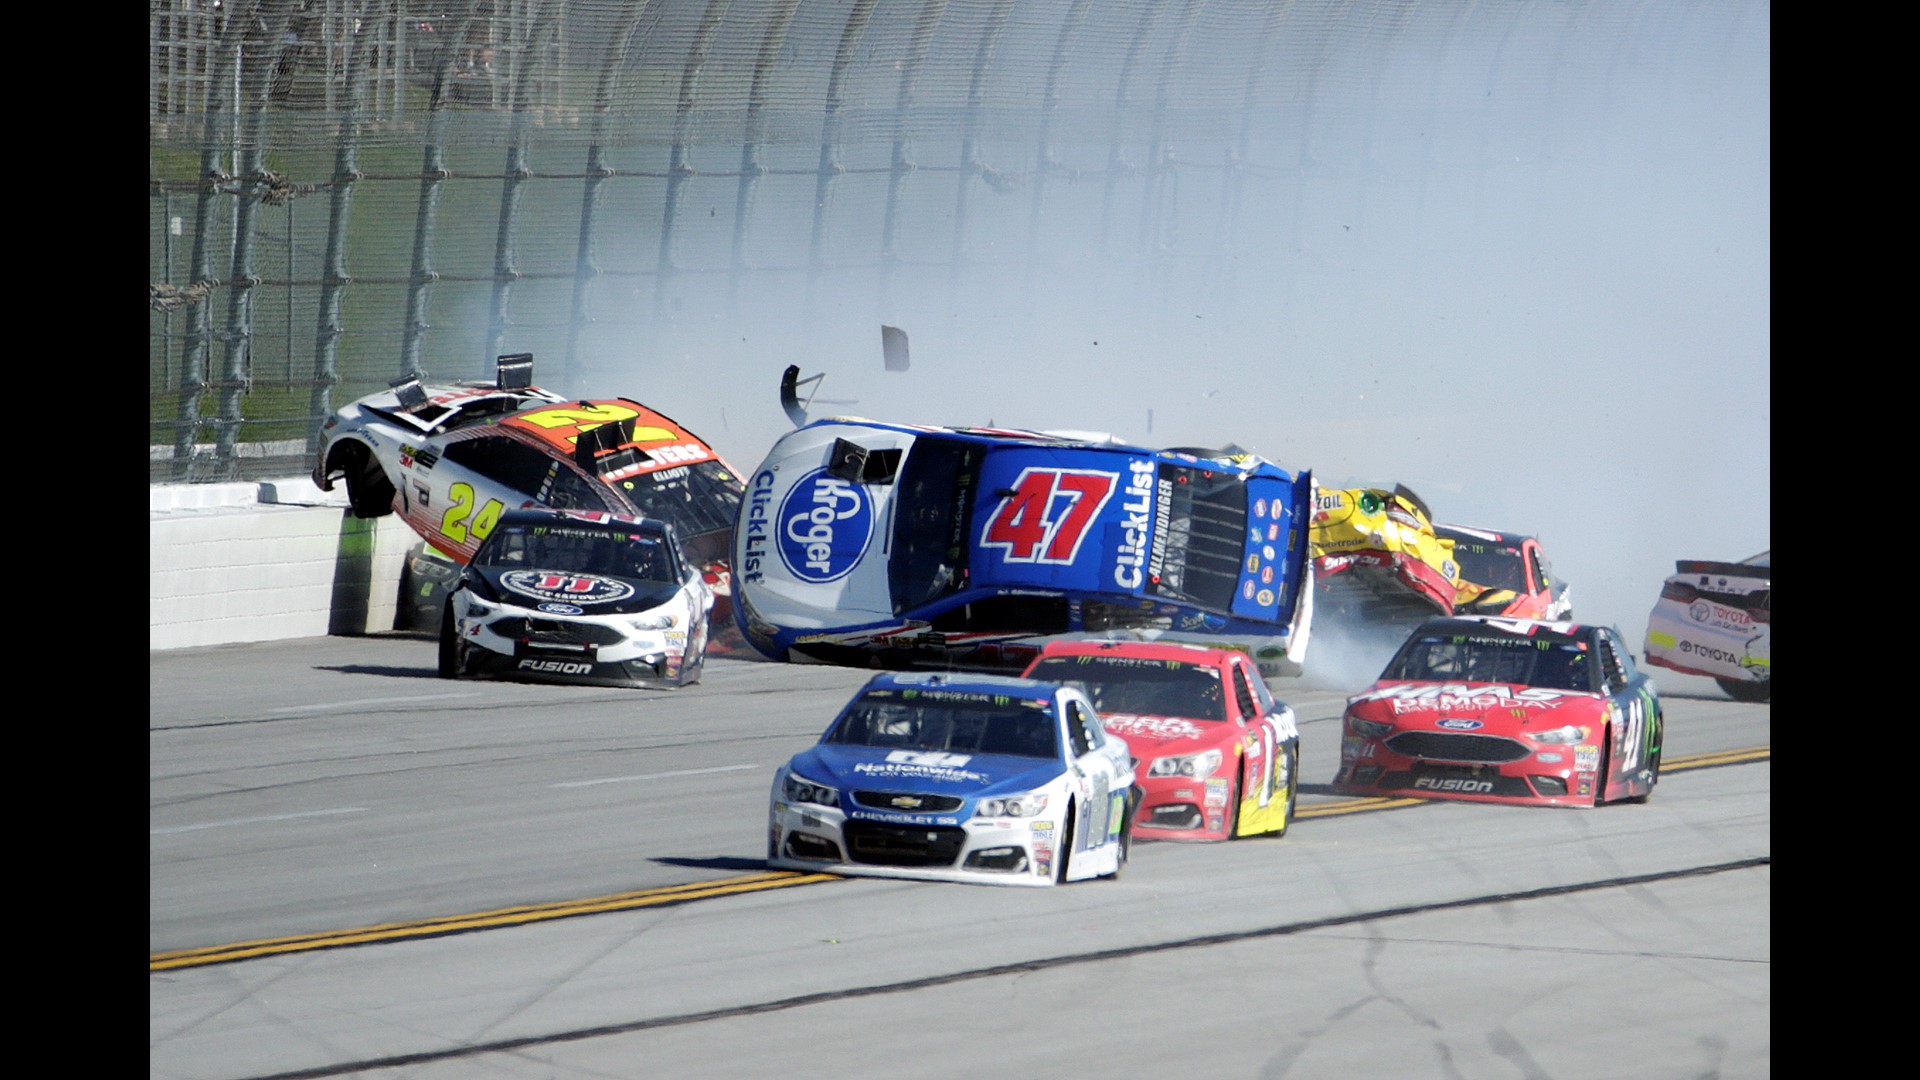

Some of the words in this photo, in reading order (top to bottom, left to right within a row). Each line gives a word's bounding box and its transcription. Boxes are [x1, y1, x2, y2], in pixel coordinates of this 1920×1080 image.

[652, 466, 692, 482] ELLIOTT
[439, 482, 505, 546] 24
[980, 466, 1121, 566] 47
[1113, 458, 1155, 589] ClickList
[744, 469, 775, 585] ClickList
[787, 477, 862, 574] Kroger
[1147, 477, 1174, 578] ALLMENDINGER
[1713, 606, 1750, 625] TOYOTA
[470, 625, 481, 636] 4
[1694, 643, 1737, 664] TOYOTA
[518, 659, 593, 675] FUSION
[1499, 697, 1563, 710] DAY
[853, 762, 981, 780] Nationwide
[1414, 778, 1493, 793] FUSION
[852, 810, 932, 824] CHEVROLET
